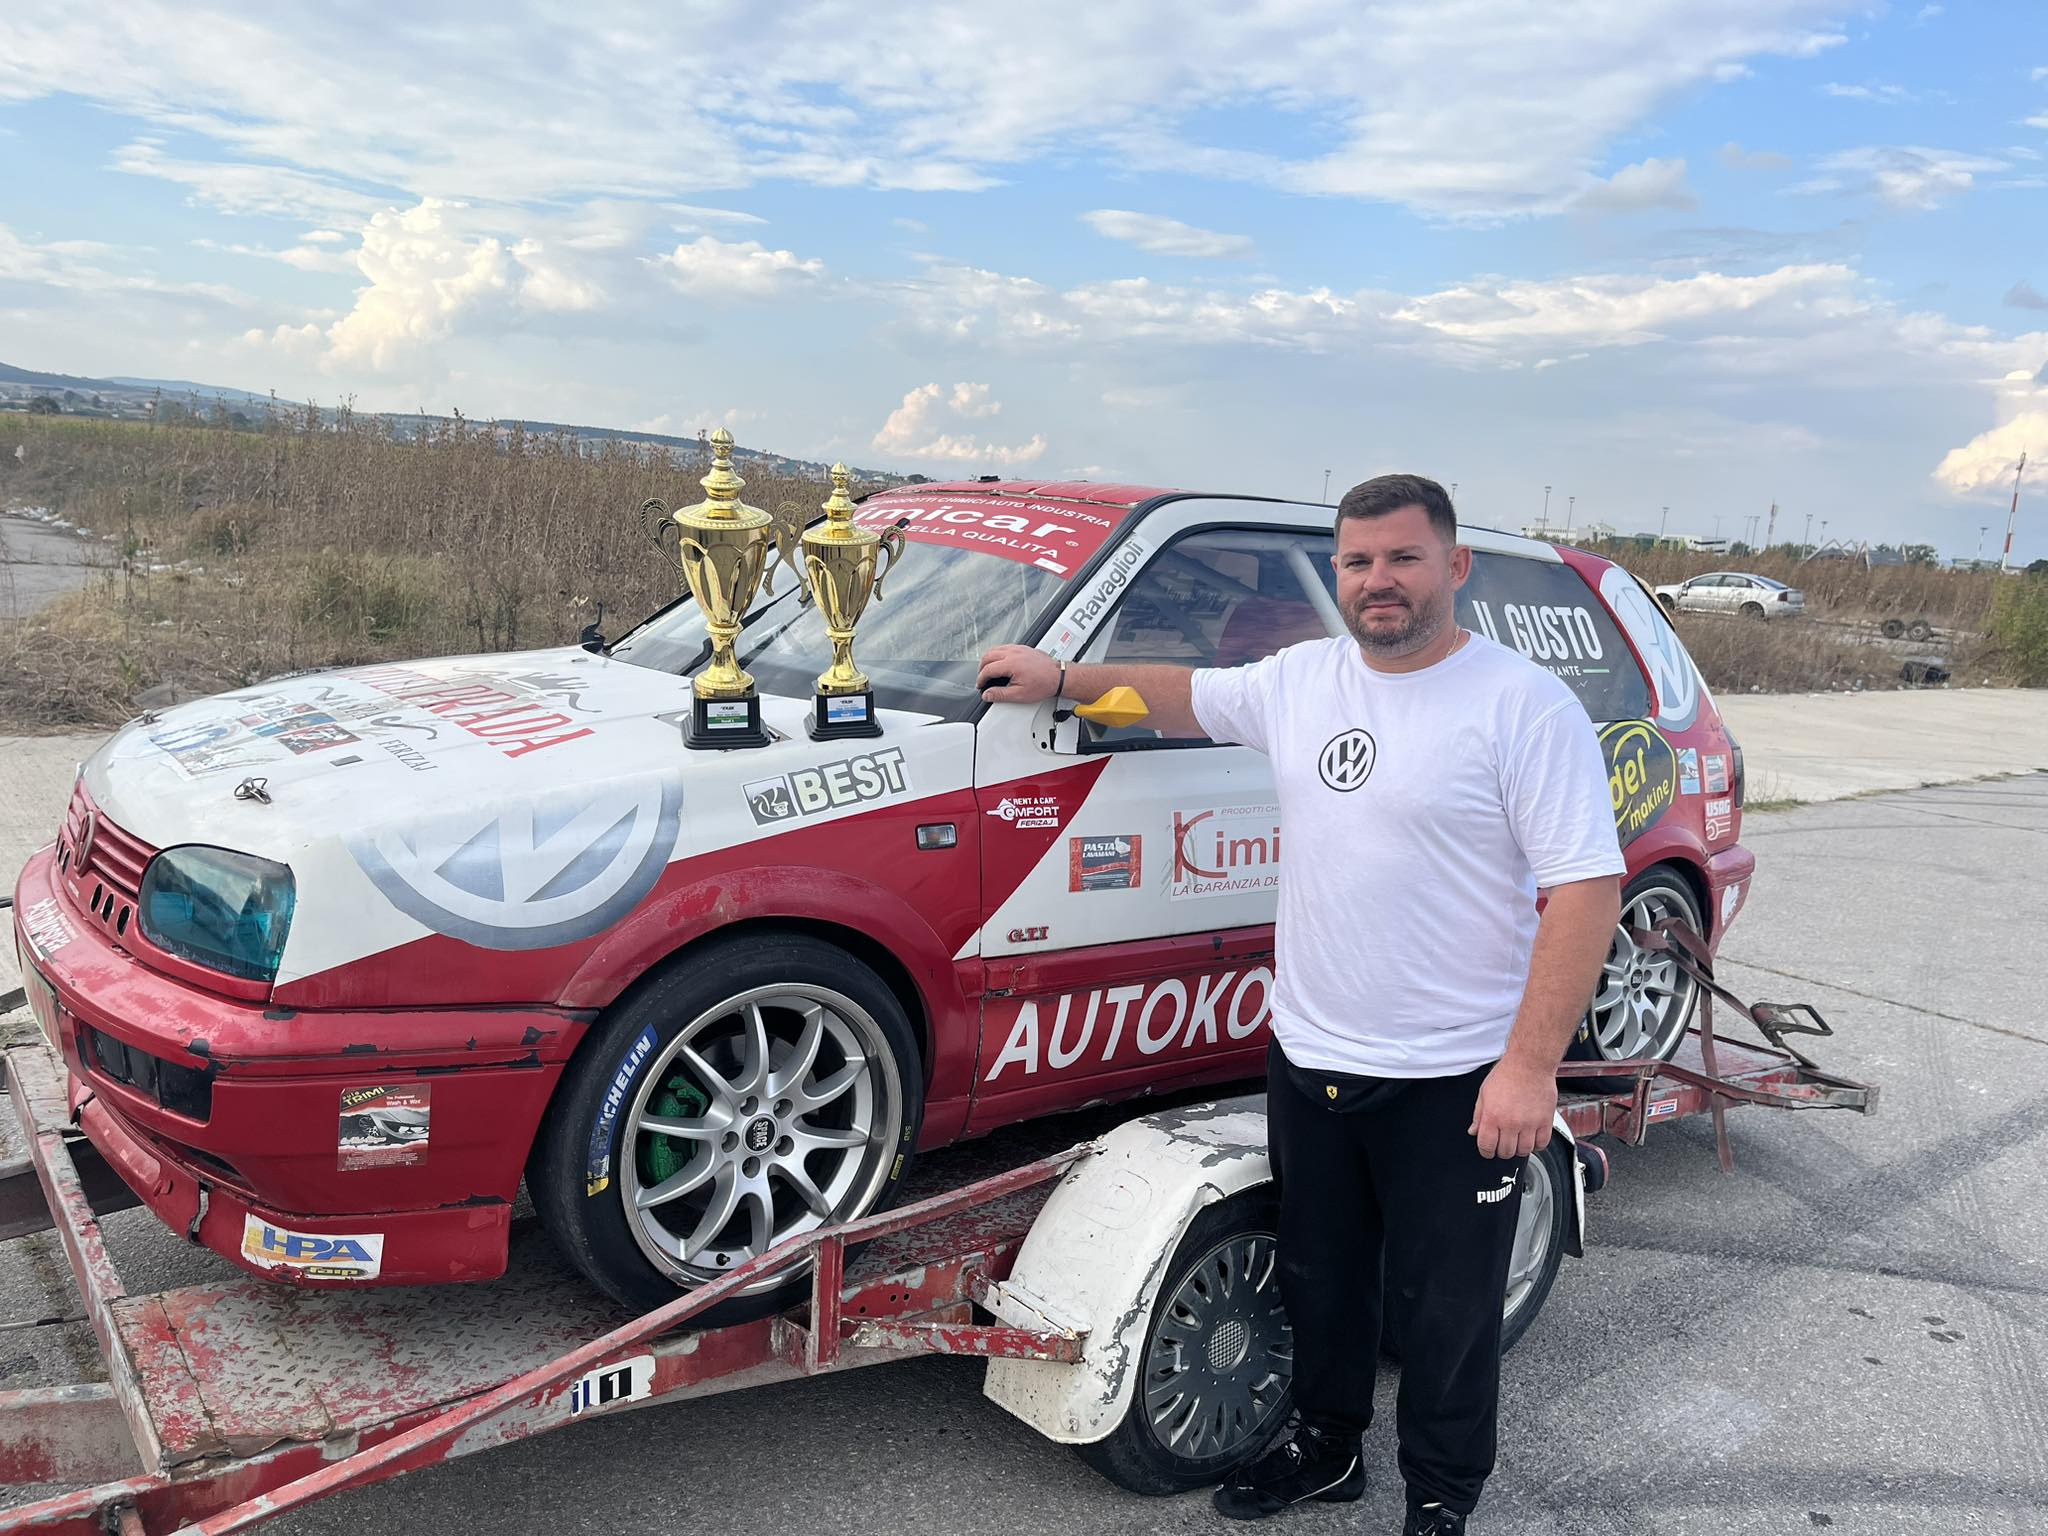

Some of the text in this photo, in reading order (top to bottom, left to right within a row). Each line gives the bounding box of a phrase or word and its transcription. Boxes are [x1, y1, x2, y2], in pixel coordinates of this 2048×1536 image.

[853, 502, 1076, 538] imicar
[986, 499, 1025, 508] AUTO
[1027, 504, 1111, 528] INDUSTRIA
[961, 531, 1058, 559] QUALITA
[1070, 540, 1144, 631] Ravaglioli
[1503, 603, 1603, 660] GUSTO
[398, 684, 596, 759] PRADA
[377, 739, 438, 772] FERIZAJ
[789, 745, 906, 815] BEST
[1221, 807, 1264, 815] PRODOTTI
[1630, 779, 1670, 831] makine
[1083, 842, 1115, 852] PASTA
[1173, 885, 1189, 897] LA
[1193, 878, 1261, 894] GARANZIA
[1006, 926, 1049, 943] GTI
[344, 1087, 385, 1106] TRIMI
[756, 1121, 769, 1148] SPACE
[263, 1226, 374, 1262] HPA
